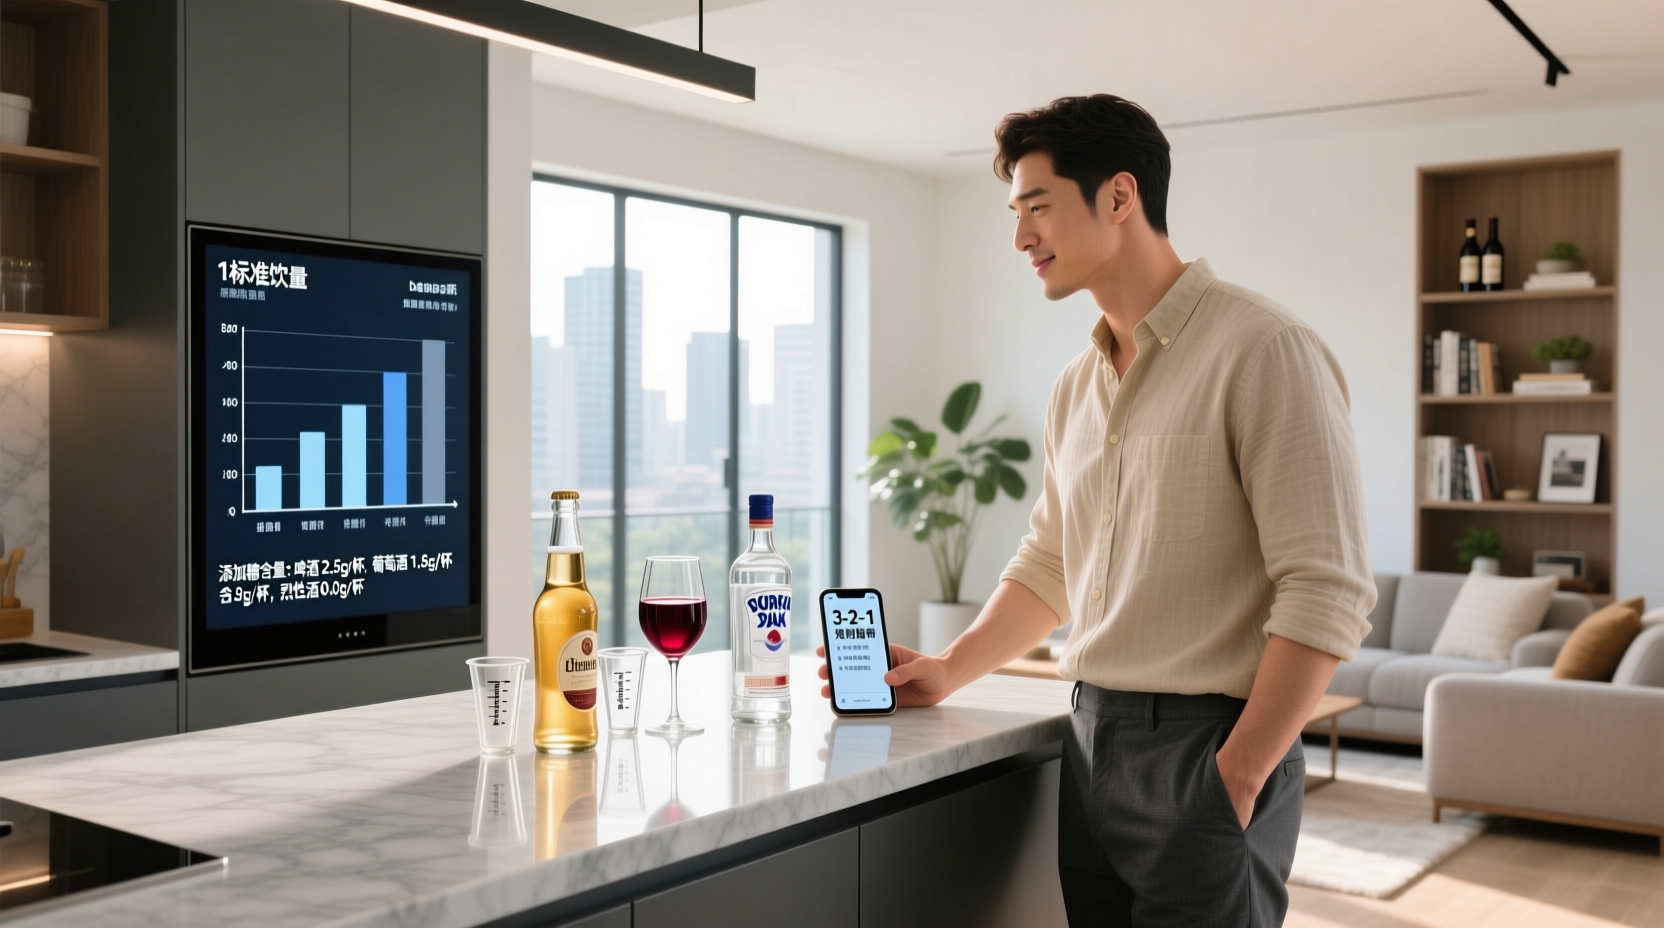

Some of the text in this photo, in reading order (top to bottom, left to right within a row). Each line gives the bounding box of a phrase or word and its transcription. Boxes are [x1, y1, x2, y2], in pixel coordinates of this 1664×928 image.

[218, 259, 308, 290] 1标准饮量
[832, 609, 874, 625] 3-2-1
